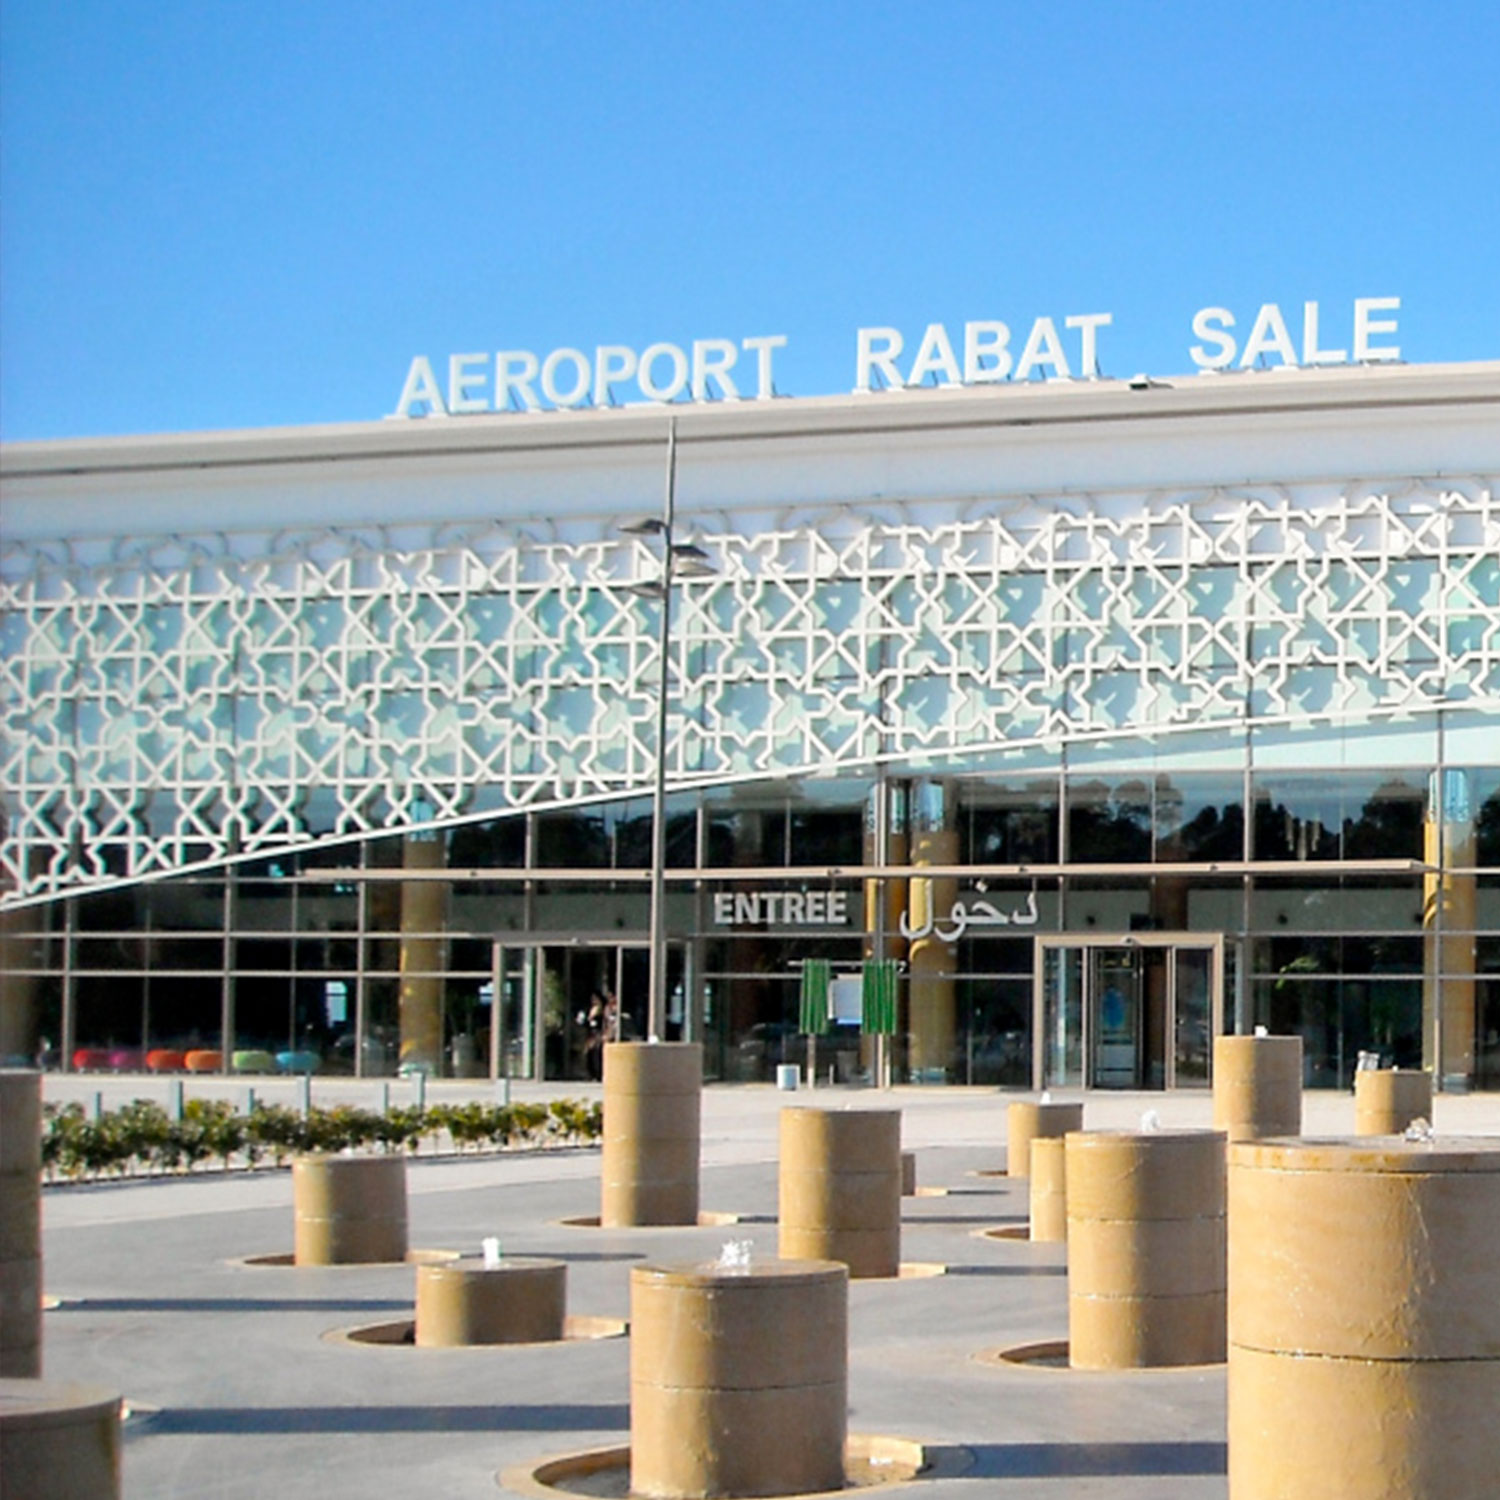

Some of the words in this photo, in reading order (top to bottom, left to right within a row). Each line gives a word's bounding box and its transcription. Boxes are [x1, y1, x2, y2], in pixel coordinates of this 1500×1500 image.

[394, 335, 788, 416] AEROPORT
[855, 313, 1112, 391] RABAT
[1189, 297, 1402, 374] SALE
[899, 878, 1038, 942] دخول
